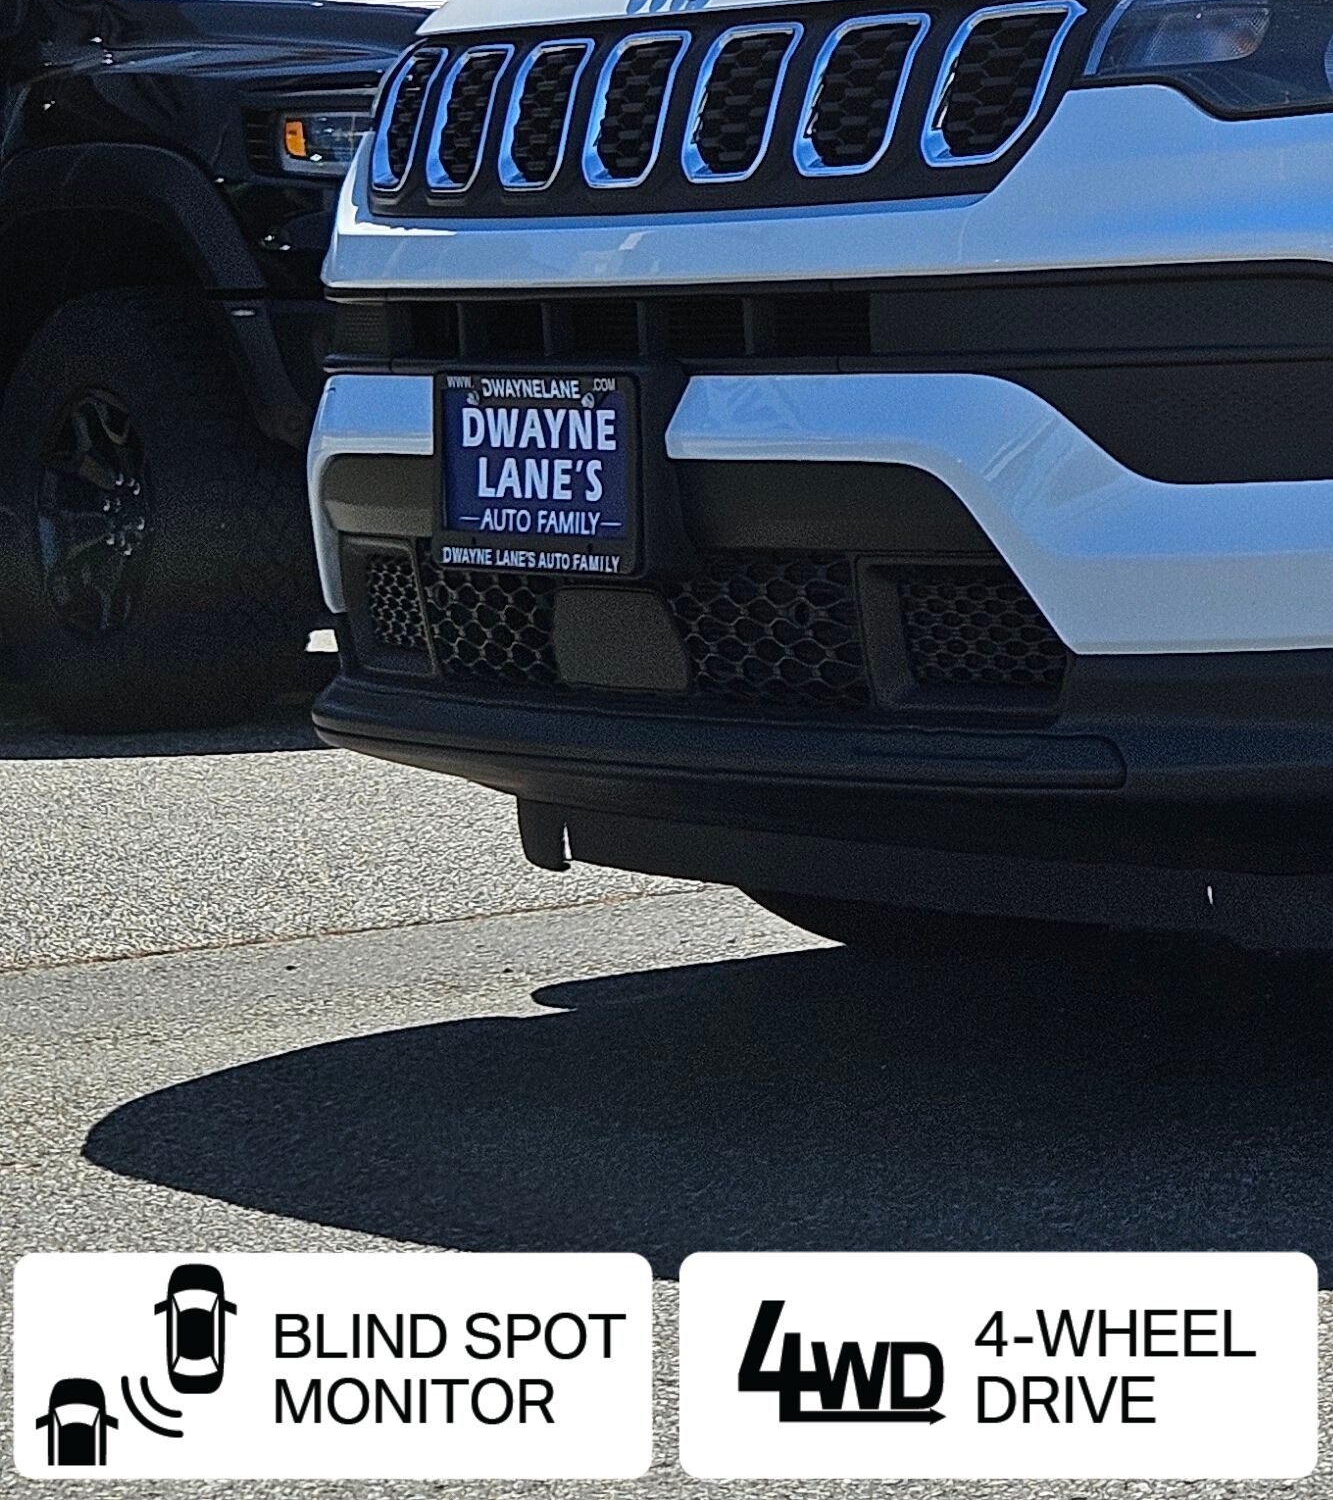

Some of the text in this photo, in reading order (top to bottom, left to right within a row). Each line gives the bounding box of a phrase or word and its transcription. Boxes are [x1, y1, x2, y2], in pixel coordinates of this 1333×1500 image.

[481, 378, 582, 400] DWAYNELANE
[462, 407, 617, 451] DWAYNE
[478, 457, 603, 502] LANE'S
[479, 508, 601, 535] AUTO FAMILY
[442, 546, 620, 573] DWAYNE LANE'S AUTO FAMILY
